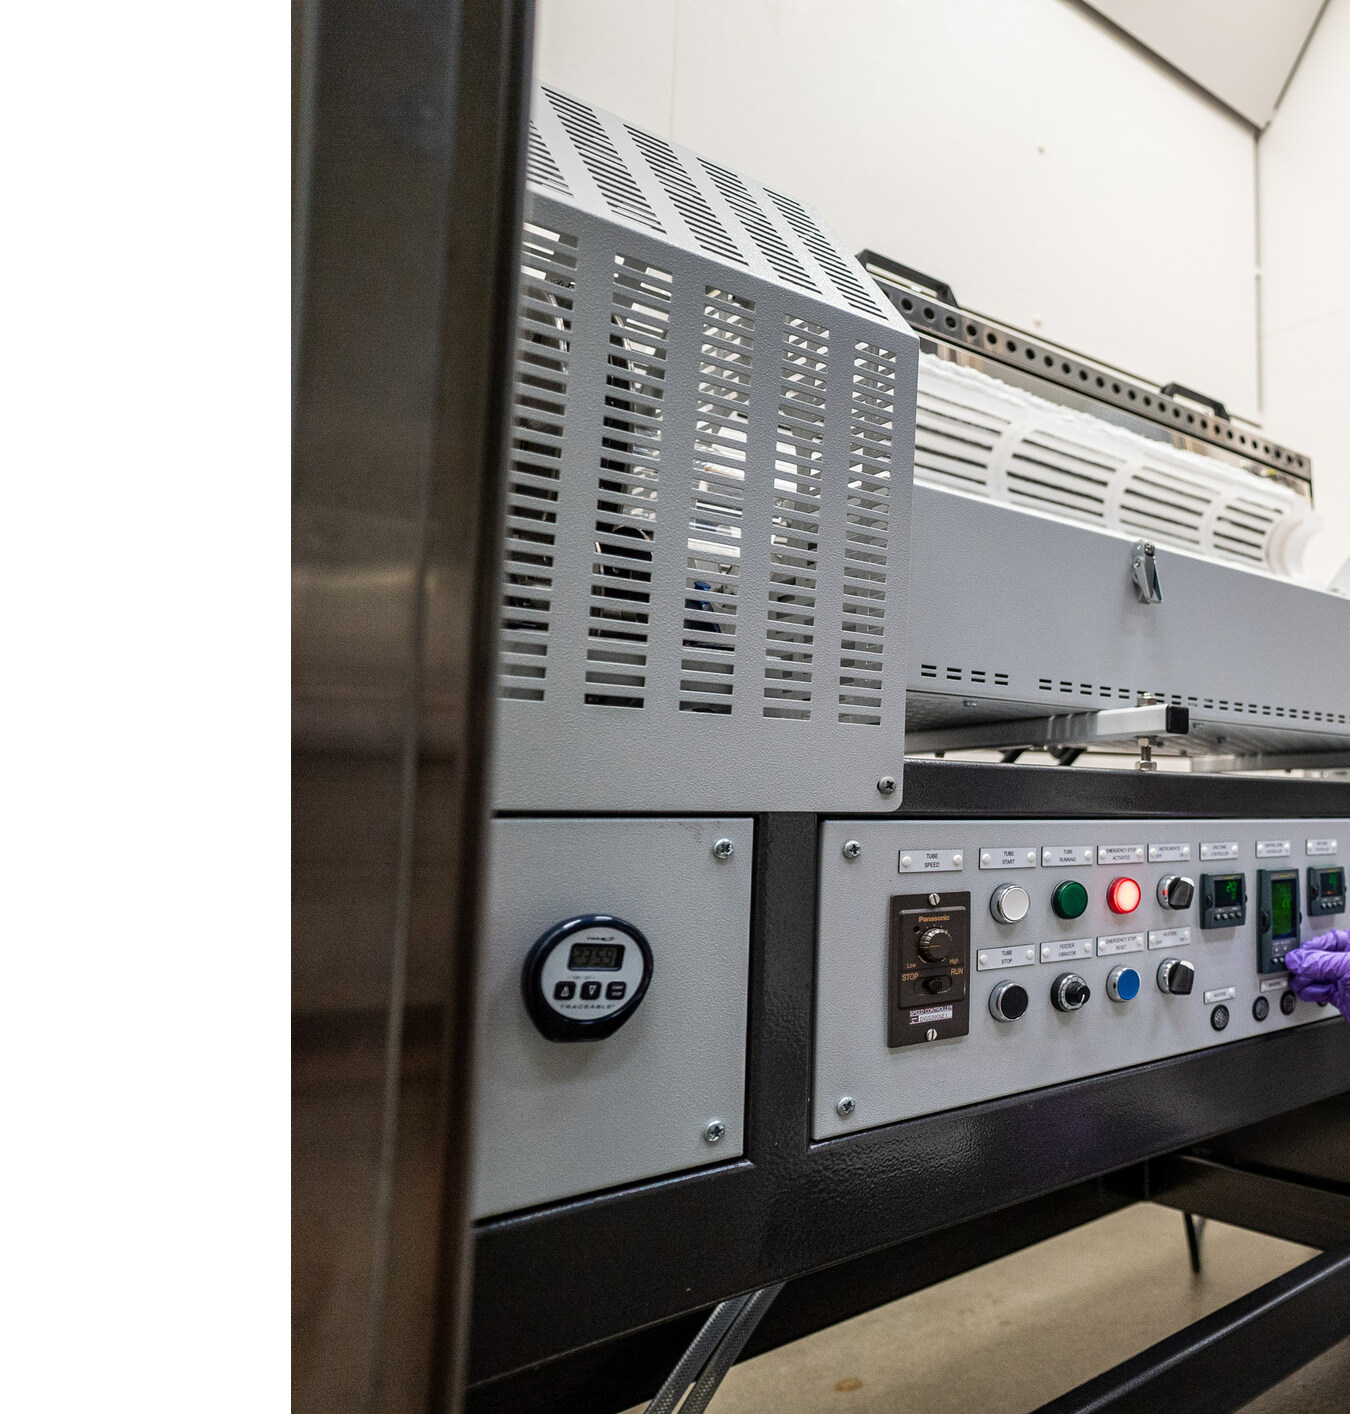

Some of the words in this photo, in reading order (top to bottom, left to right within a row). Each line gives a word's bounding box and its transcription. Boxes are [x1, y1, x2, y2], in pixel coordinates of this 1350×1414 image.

[918, 915, 951, 923] Panasonic
[1105, 937, 1127, 945] EMERGENCY
[1057, 950, 1077, 958] VIBRATOR
[902, 973, 919, 981] STOP
[951, 968, 964, 976] RUN
[909, 1007, 925, 1016] SPEED
[924, 1004, 952, 1014] CONTROLLER
